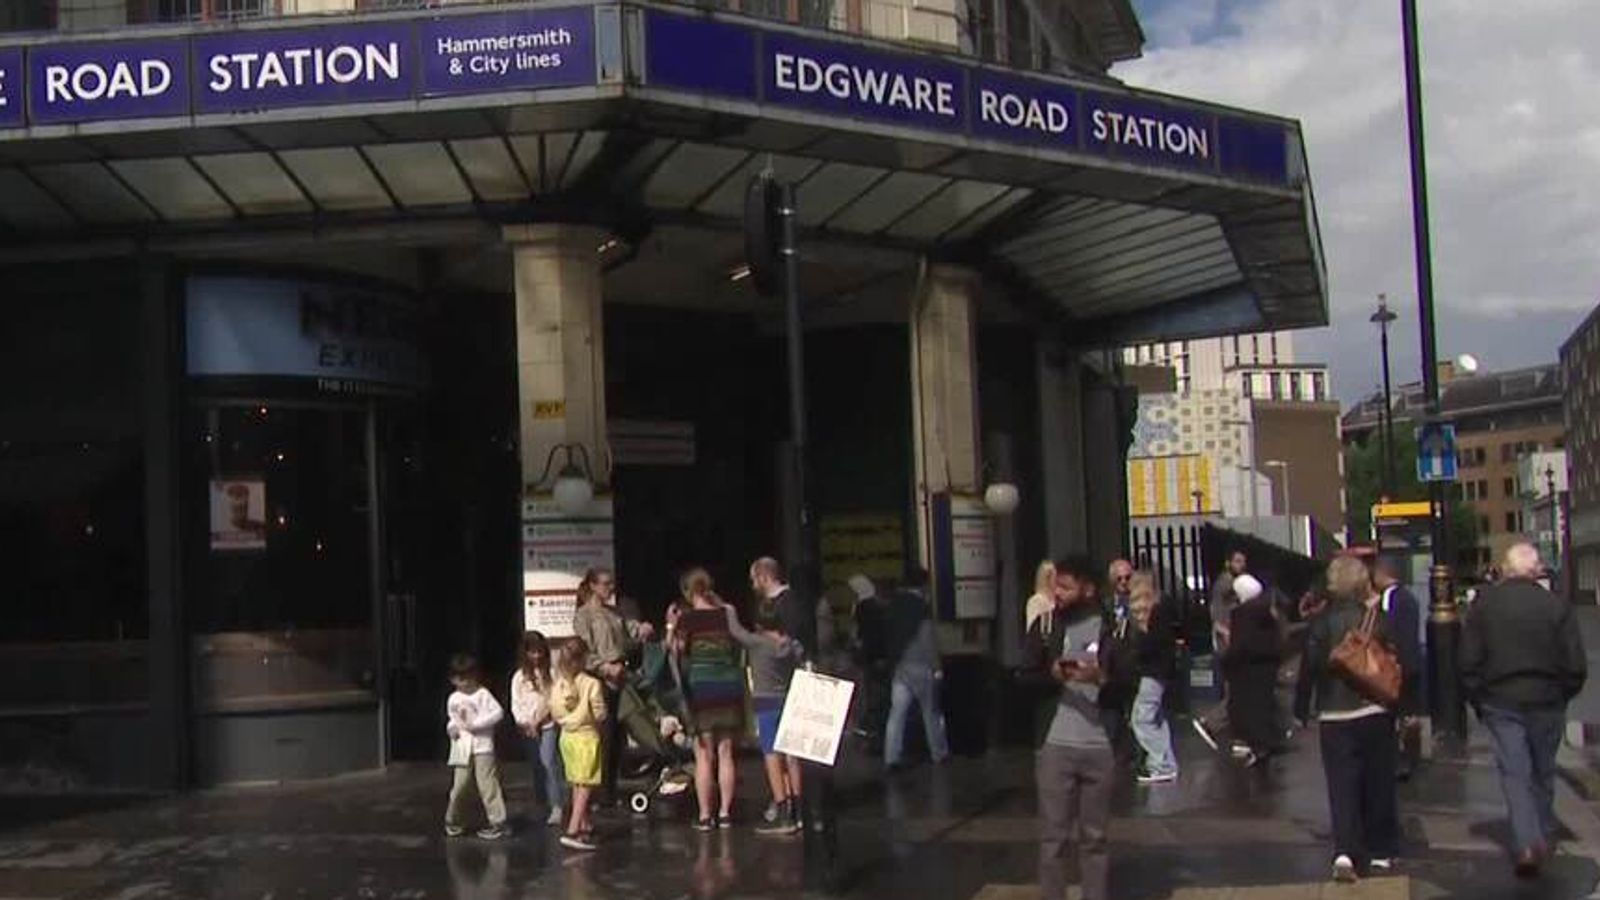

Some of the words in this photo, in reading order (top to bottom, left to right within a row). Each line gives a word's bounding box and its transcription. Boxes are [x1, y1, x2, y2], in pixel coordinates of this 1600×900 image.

[437, 27, 571, 55] Hammersmith
[448, 57, 463, 75] &
[469, 54, 509, 75] City
[515, 51, 562, 70] lines
[45, 59, 172, 103] ROAD
[209, 42, 399, 92] STATION
[775, 53, 955, 116] EDGWARE
[981, 89, 1068, 133] ROAD
[1092, 108, 1208, 158] STATION
